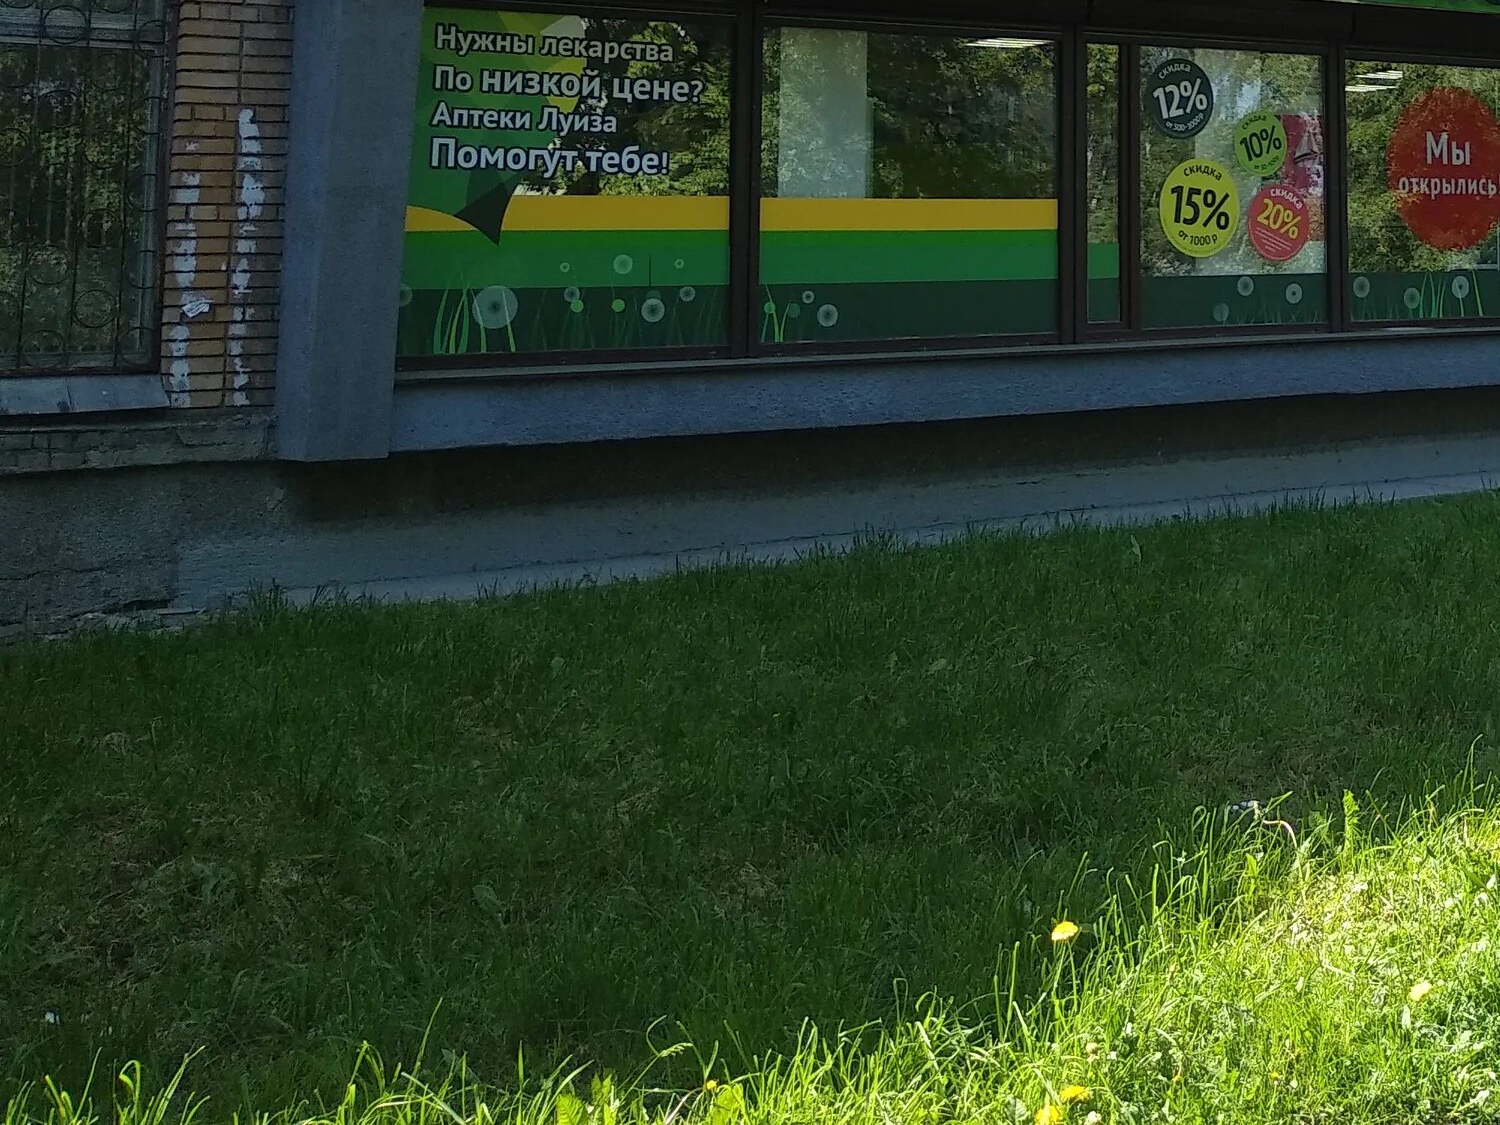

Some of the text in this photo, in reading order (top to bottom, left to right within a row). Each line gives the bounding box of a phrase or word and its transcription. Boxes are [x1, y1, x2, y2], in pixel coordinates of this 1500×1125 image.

[435, 23, 674, 63] Нужны лекарства
[433, 65, 704, 104] По низкой цене?
[1158, 62, 1191, 80] скидка
[1153, 78, 1208, 120] 12%
[431, 101, 618, 136] Аптеки Луиза
[1242, 114, 1267, 130] скидка
[430, 137, 669, 177] Помогут тебе!
[1239, 125, 1282, 161] 10%
[1425, 130, 1471, 165] Мы
[1183, 163, 1222, 181] скидка
[1171, 185, 1230, 230] 15%
[1270, 187, 1303, 209] скидка
[1257, 198, 1301, 240] 20%
[1178, 230, 1189, 241] от
[1190, 235, 1211, 246] 1000
